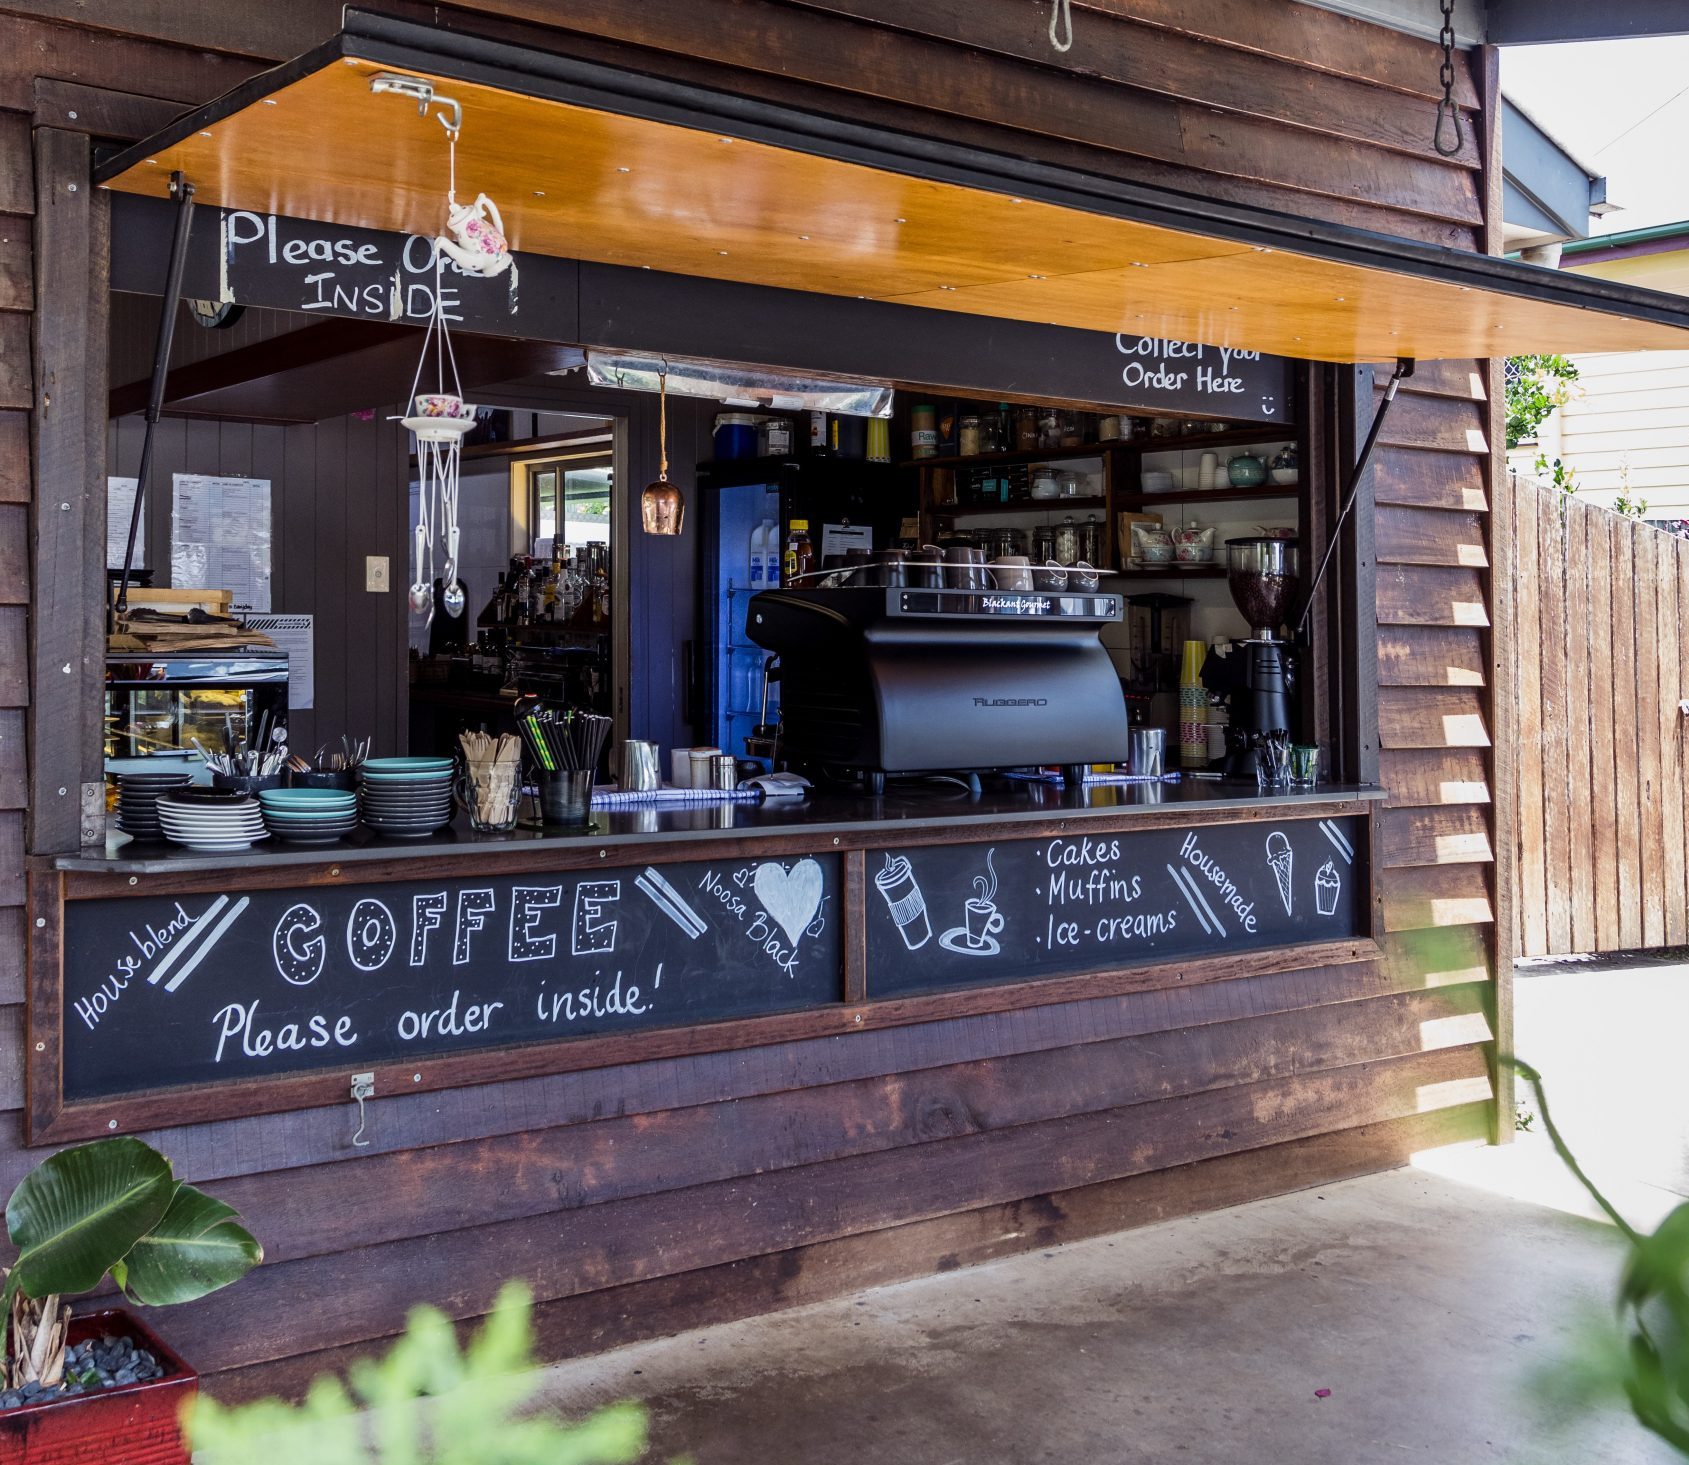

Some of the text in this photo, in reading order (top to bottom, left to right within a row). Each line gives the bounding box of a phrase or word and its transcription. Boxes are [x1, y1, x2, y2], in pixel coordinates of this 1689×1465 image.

[228, 211, 383, 265] Please
[1115, 333, 1203, 359] Collect
[1123, 362, 1245, 394] Order Here
[972, 697, 1048, 707] RUGGERO
[1046, 836, 1121, 868] Cakes
[1048, 868, 1142, 906] Muffins
[1179, 831, 1257, 933] Housemade
[272, 880, 622, 986] COFFEE
[699, 870, 800, 979] Noosa Black
[1046, 910, 1177, 950] Ice-creams
[74, 901, 200, 1030] House blend
[213, 962, 663, 1063] Please order inside!
